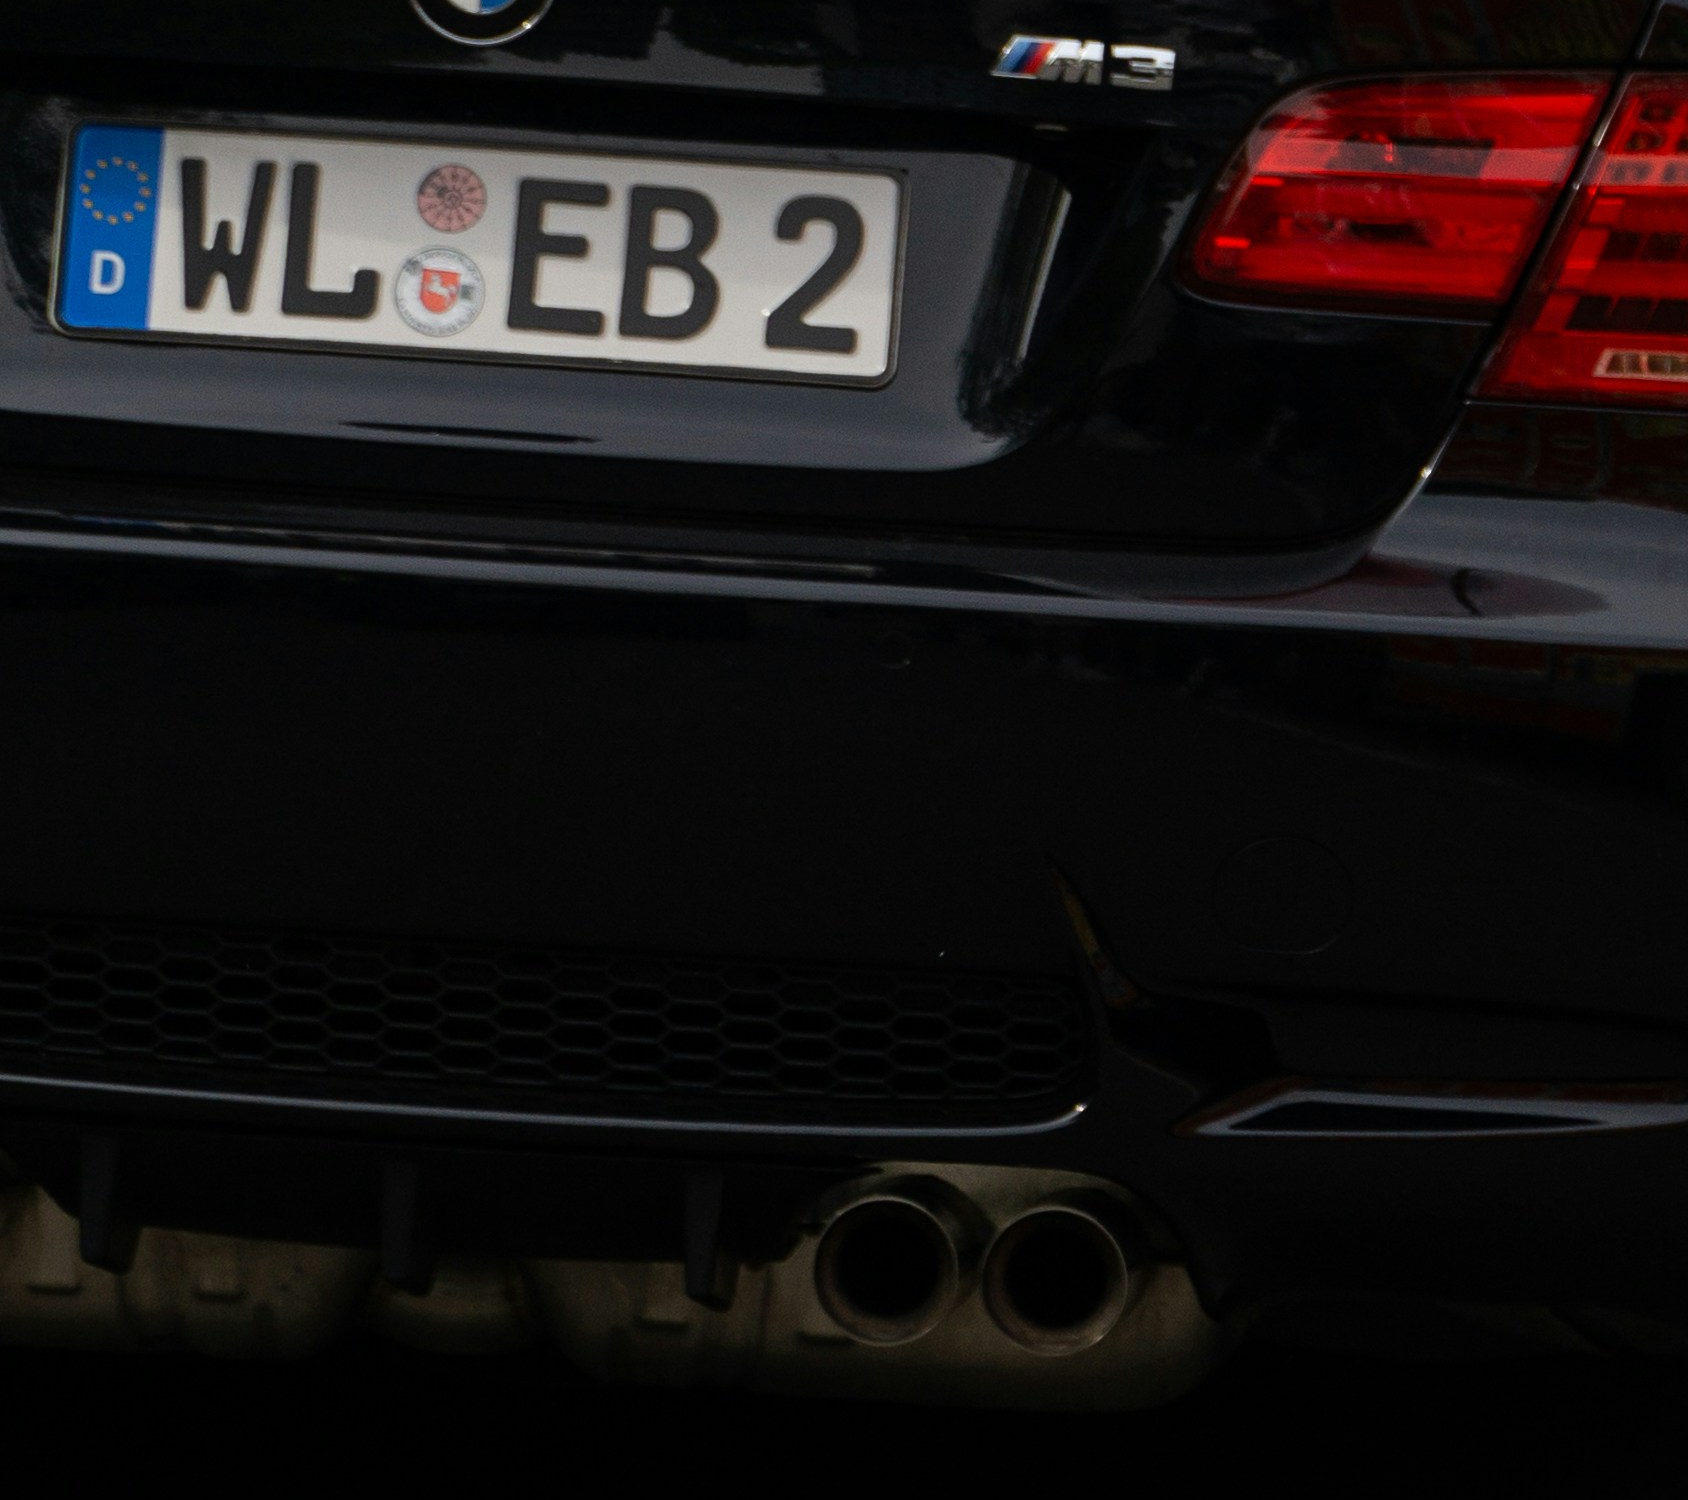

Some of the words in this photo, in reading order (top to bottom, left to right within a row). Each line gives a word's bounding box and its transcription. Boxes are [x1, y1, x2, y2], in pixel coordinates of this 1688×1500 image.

[992, 35, 1175, 90] M3
[89, 249, 126, 295] D
[179, 158, 380, 319] WL
[506, 178, 720, 340] EB
[764, 195, 866, 354] 2
